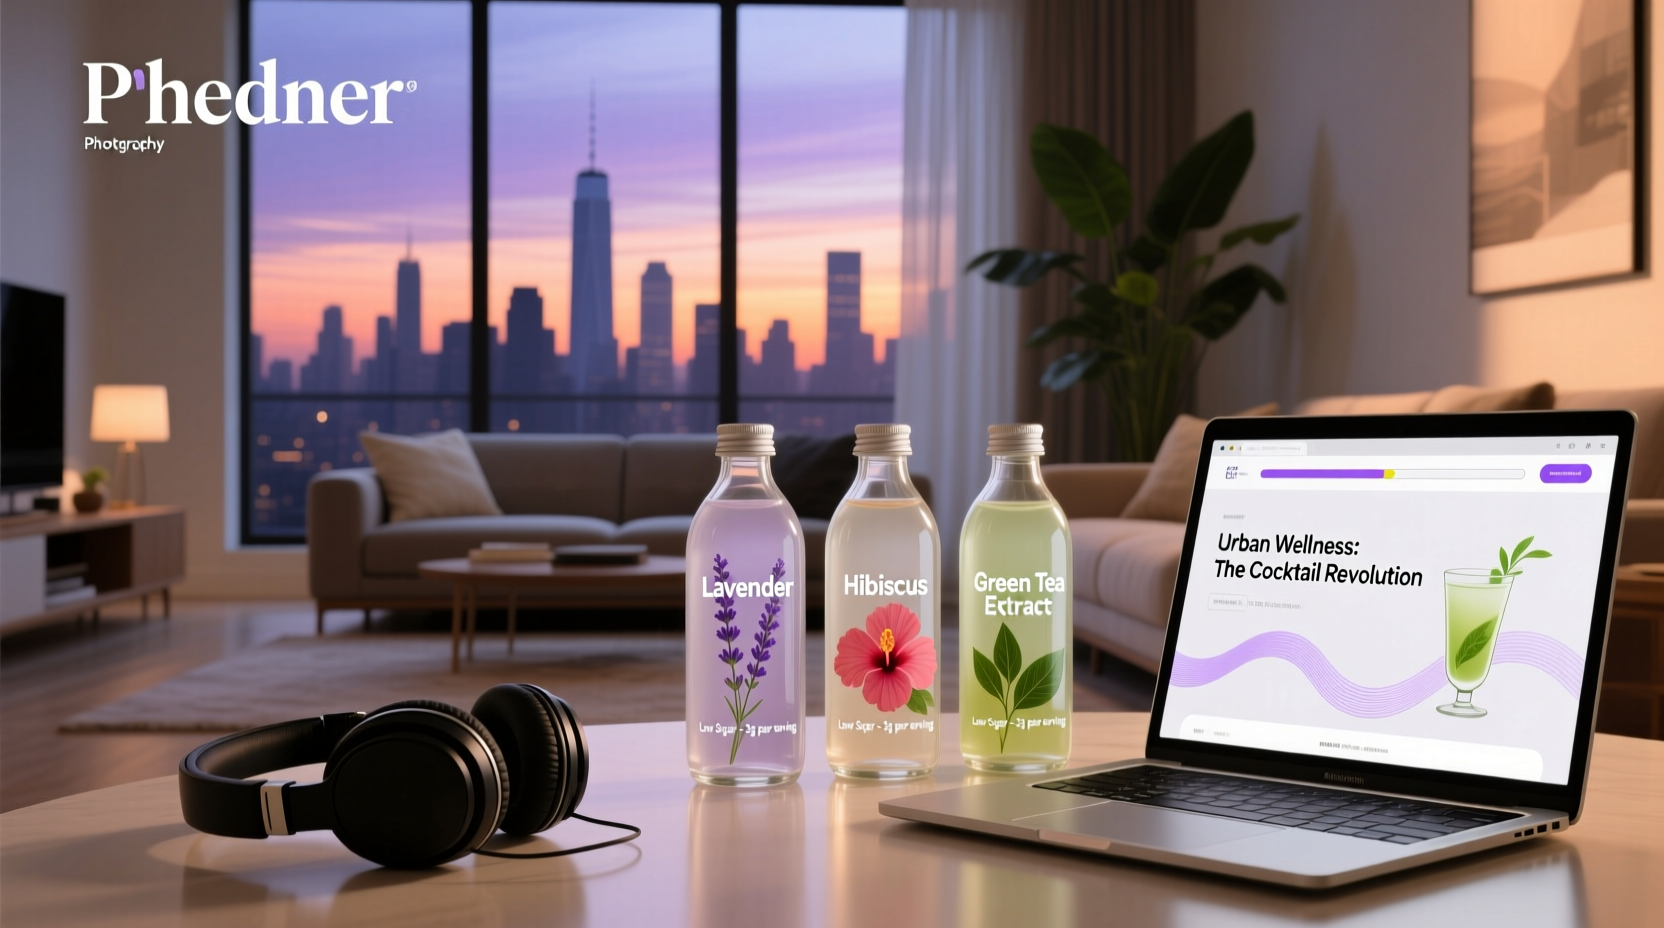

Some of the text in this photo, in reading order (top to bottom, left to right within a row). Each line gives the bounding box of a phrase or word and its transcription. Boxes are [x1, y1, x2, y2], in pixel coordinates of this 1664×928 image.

[1218, 532, 1360, 555] Urban Wellness:
[973, 571, 1065, 593] Green Tea
[1214, 558, 1423, 587] The Cocktail Revolution
[702, 574, 795, 598] Lavender
[844, 574, 928, 596] Hibiscus
